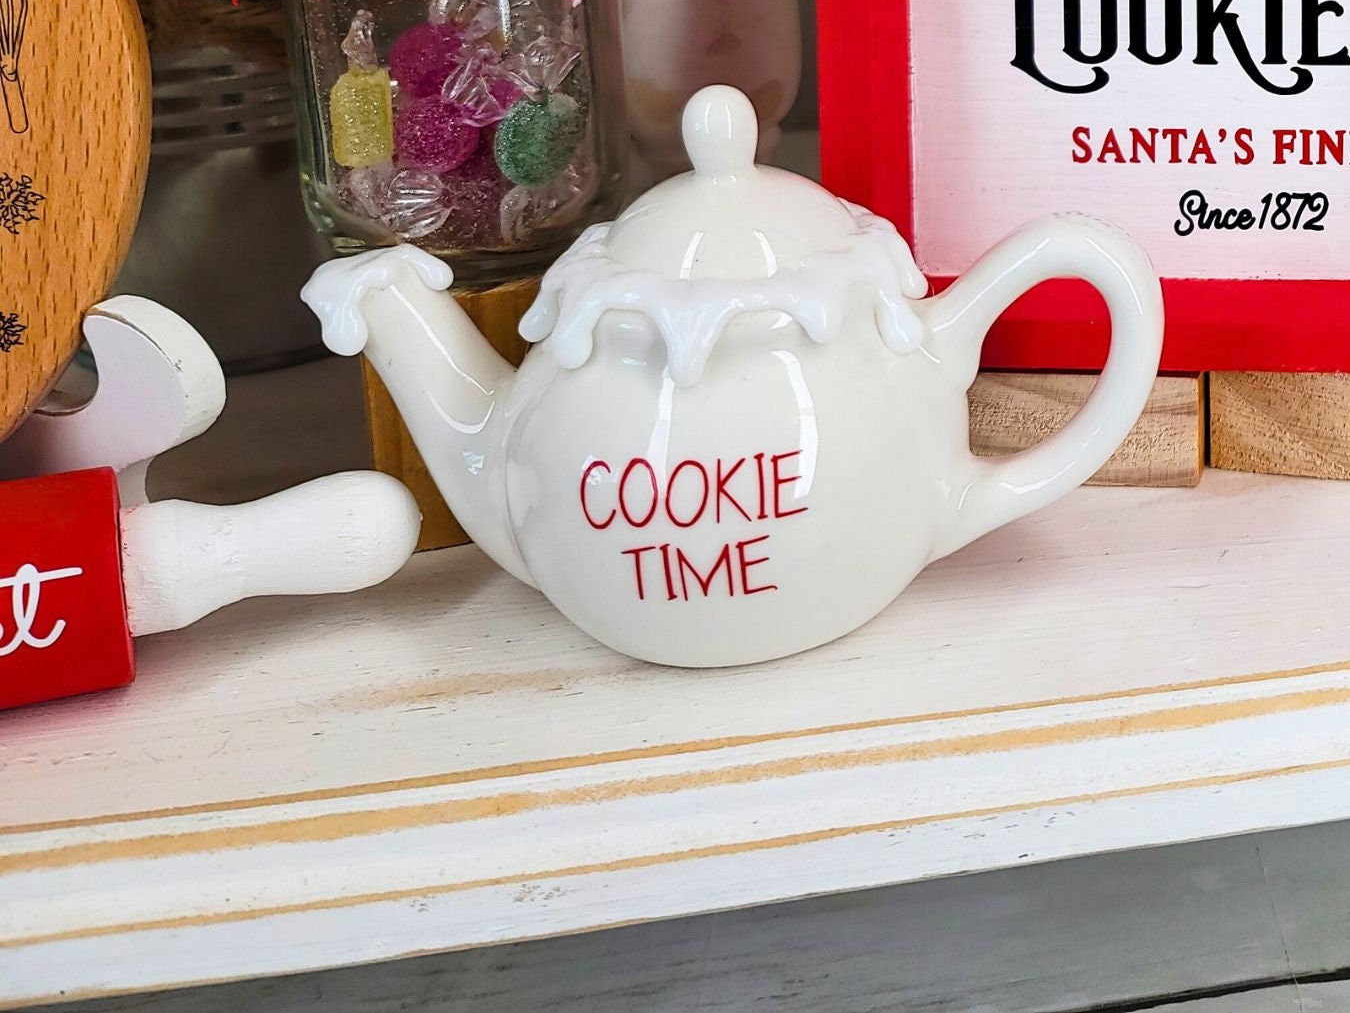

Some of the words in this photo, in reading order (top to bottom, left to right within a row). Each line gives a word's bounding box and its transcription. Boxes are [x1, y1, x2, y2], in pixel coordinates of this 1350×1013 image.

[1071, 126, 1255, 166] SANTA'S
[1173, 189, 1257, 237] Since
[1257, 191, 1330, 232] 1872
[579, 450, 809, 531] COOKIE
[620, 534, 778, 601] TIME
